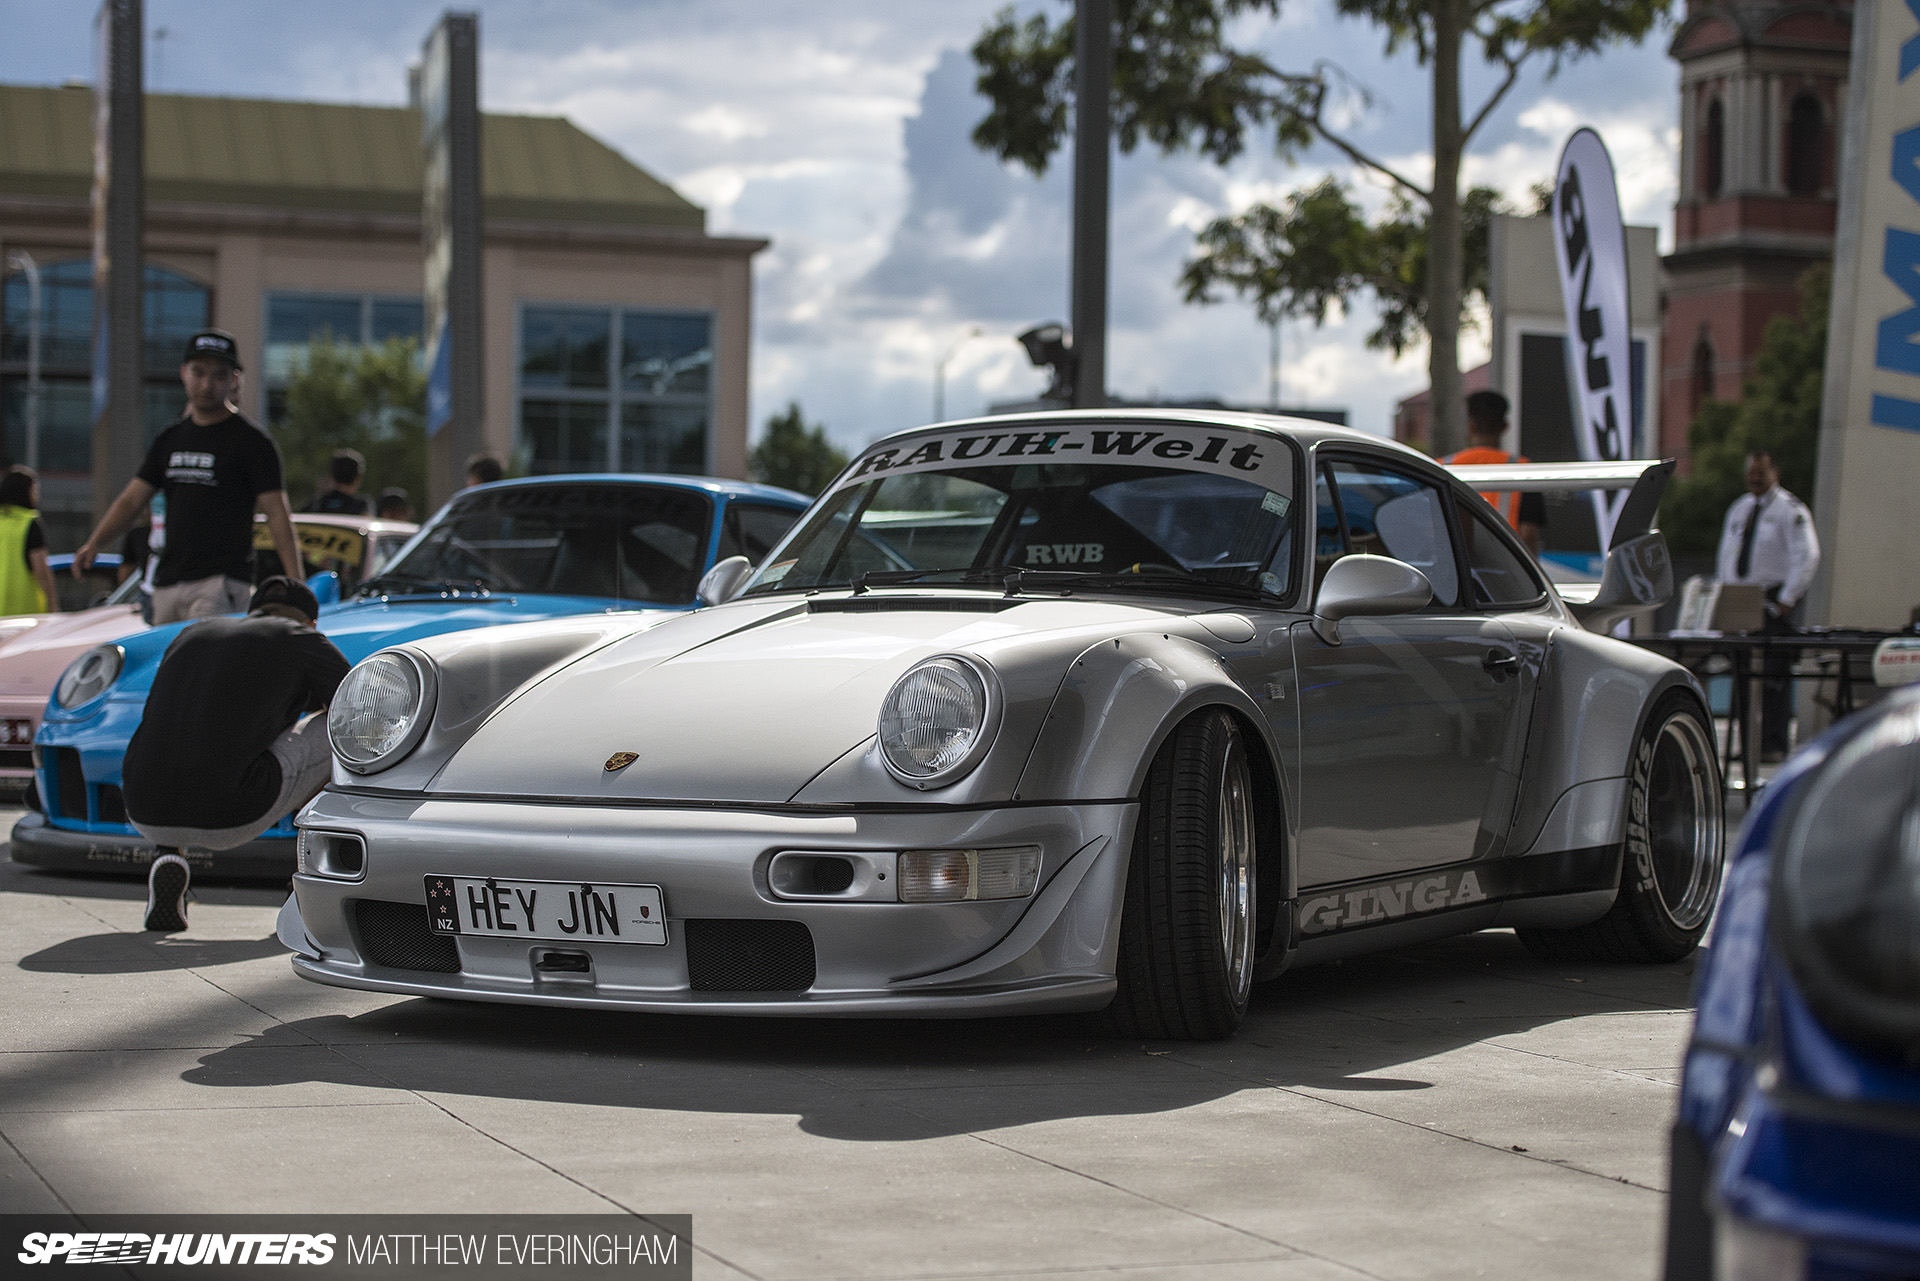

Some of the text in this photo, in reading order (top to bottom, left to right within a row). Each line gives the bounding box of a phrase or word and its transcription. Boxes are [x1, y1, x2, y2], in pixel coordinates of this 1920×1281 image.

[852, 431, 1264, 479] RAUH-Welt
[1026, 543, 1104, 564] RWB
[437, 918, 454, 930] NZ
[467, 885, 620, 936] HEY JIN
[1300, 870, 1487, 935] GINGA
